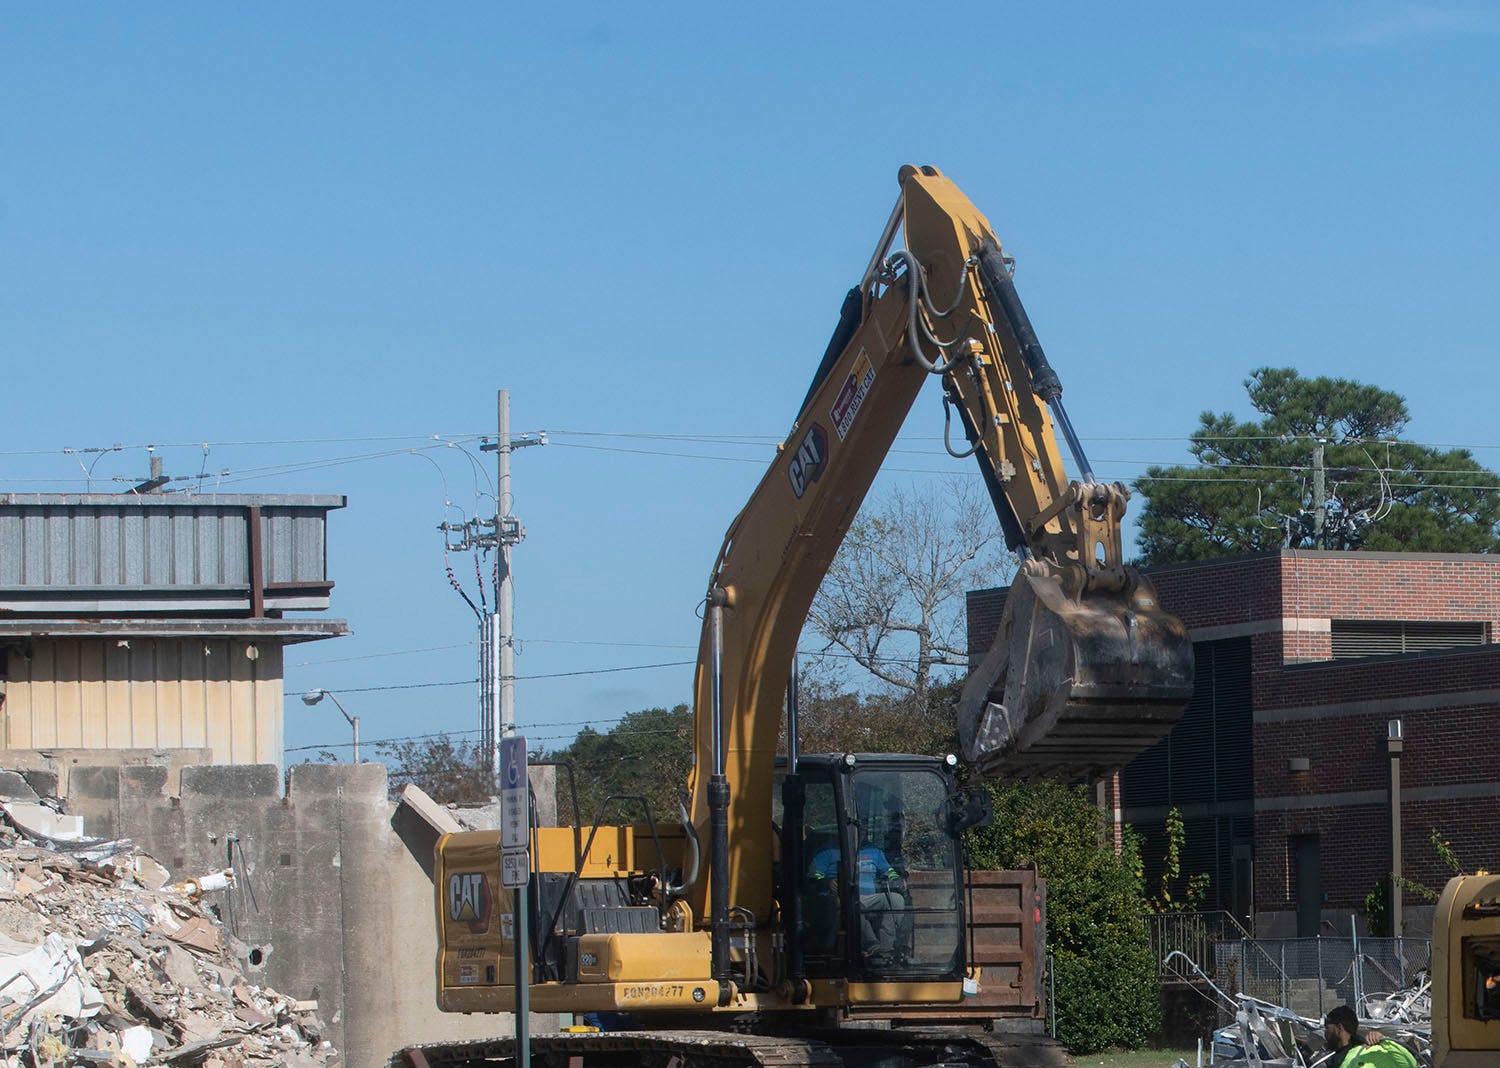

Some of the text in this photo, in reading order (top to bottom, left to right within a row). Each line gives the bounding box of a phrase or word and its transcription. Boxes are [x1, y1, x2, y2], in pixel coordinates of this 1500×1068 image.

[850, 385, 865, 416] RENT
[863, 367, 875, 389] CAT
[789, 429, 820, 498] CAT
[450, 874, 482, 920] CAT
